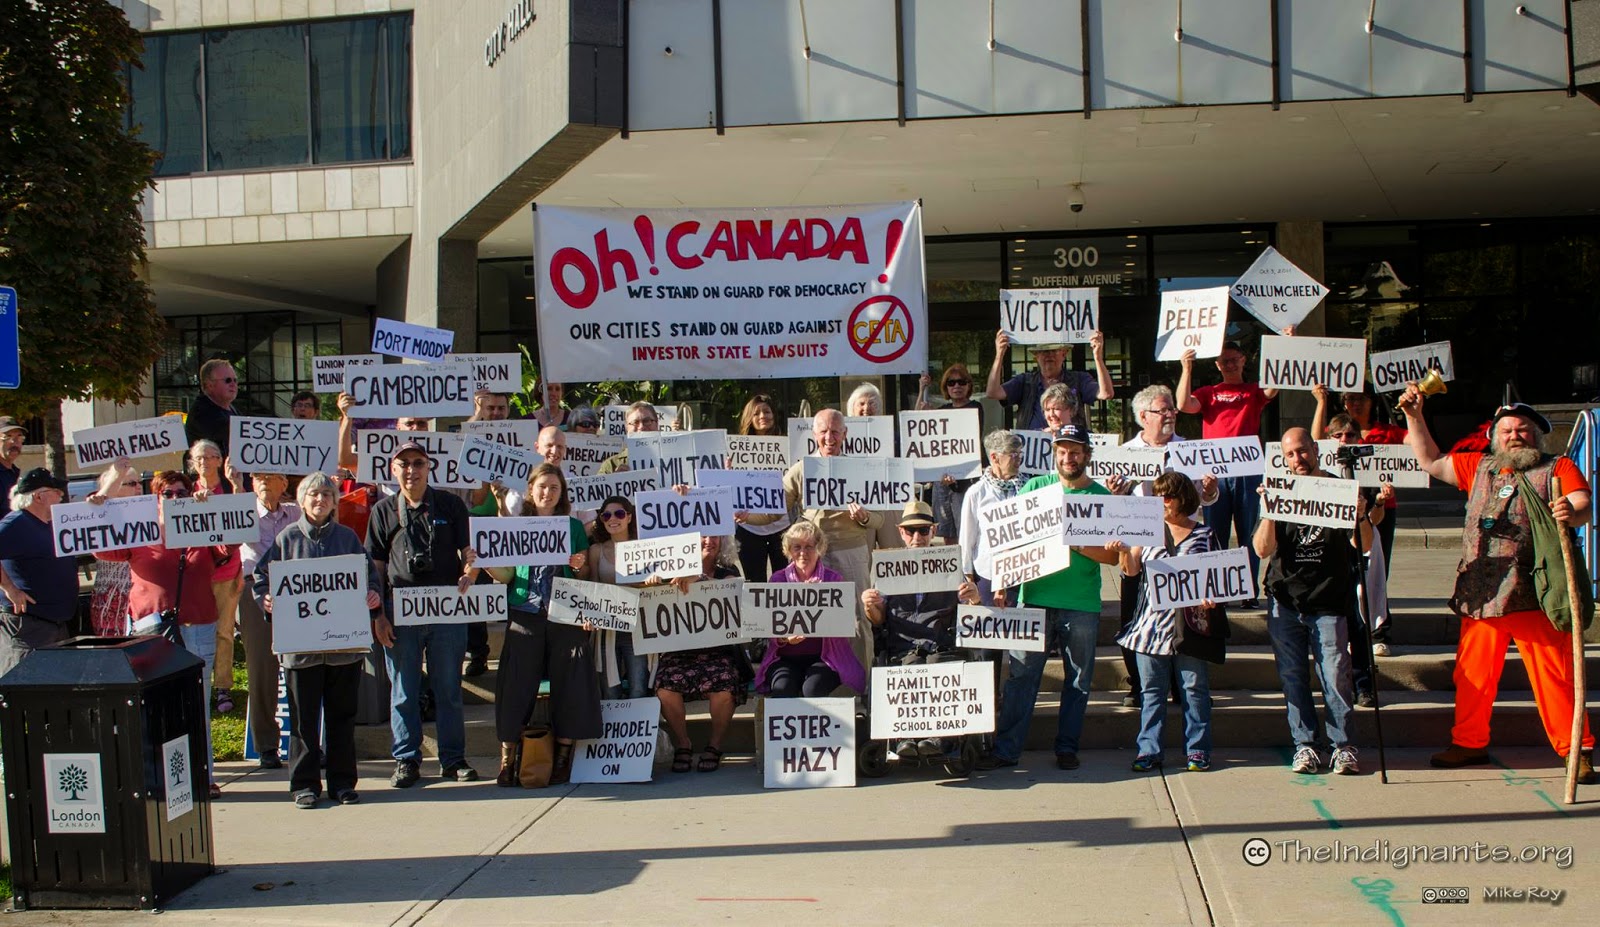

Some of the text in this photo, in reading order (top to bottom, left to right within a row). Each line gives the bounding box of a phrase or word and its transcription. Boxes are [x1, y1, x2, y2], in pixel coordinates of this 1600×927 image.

[485, 22, 507, 68] CITY
[550, 215, 659, 309] Oh!
[1053, 246, 1099, 268] 300
[627, 282, 867, 299] WE STAND ON GUARD FOR DEMOCRACY
[1032, 274, 1121, 287] DUFFERIN AVENUE
[1235, 284, 1320, 297] SPALLUMCHEEN
[1004, 300, 1094, 332] VICTORIA
[1273, 303, 1288, 312] BC
[1165, 306, 1219, 331] PELEE
[570, 322, 602, 340] OUR
[606, 321, 661, 339] CITIES
[670, 322, 716, 337] STAND
[720, 322, 738, 336] ON
[743, 321, 784, 336] GUARD
[788, 319, 843, 334] AGAINST
[374, 329, 411, 350] PORT
[411, 338, 451, 359] MOODY
[1183, 333, 1201, 347] ON
[632, 344, 829, 361] INVESTOR STATE LAWSUITS
[315, 359, 345, 370] UNION
[1264, 358, 1358, 389] NANAIMO
[1375, 356, 1445, 386] OSHAWA
[350, 375, 469, 406] CAMBRIDGE
[476, 382, 489, 390] BC
[240, 420, 305, 441] ESSEX
[609, 423, 627, 436] BOA
[907, 418, 949, 437] PORT
[77, 430, 171, 463] NIAGRA FALLS
[367, 433, 448, 454] POLL
[729, 441, 781, 452] GREATER
[807, 436, 881, 455] DMOND
[905, 438, 975, 458] ALBERNI
[240, 443, 331, 471] COUNTY
[563, 447, 620, 463] MBERLA
[727, 452, 786, 465] VICTORIA
[1175, 446, 1260, 467] WELLAND
[1354, 457, 1423, 472] EW TECUMSE
[1211, 465, 1228, 475] ON
[1379, 473, 1394, 482] ON
[567, 478, 656, 503] GRAND FORKS
[805, 477, 847, 506] FORT
[860, 480, 911, 505] JAMES
[1266, 477, 1296, 490] NEW
[733, 486, 784, 510] LESLEY
[1263, 494, 1356, 521] WESTMINSTER
[60, 511, 107, 523] District of
[641, 501, 721, 530] SLOCAN
[983, 496, 1040, 523] VILLE DE
[1066, 502, 1104, 518] NWT
[171, 509, 255, 533] TRENT HILLS
[986, 506, 1062, 549] BAIE-COMEA
[1065, 522, 1106, 536] Association
[1107, 527, 1113, 536] of
[1116, 525, 1154, 537] Communities
[59, 521, 160, 553] CHETWYND
[209, 534, 223, 542] ON
[476, 530, 567, 559] CRANBROOK
[624, 543, 697, 562] DISTRICT OF
[995, 545, 1046, 576] FRENCH
[627, 558, 685, 576] ELKFORD
[876, 558, 958, 578] GRAND FORKS
[1001, 563, 1041, 588] RIVER
[276, 571, 358, 596] ASHBURN
[1153, 565, 1248, 604] PORT ALICE
[298, 598, 331, 618] B.C.
[402, 595, 506, 617] DUNCAN BC
[554, 589, 567, 600] BC
[570, 595, 603, 612] School
[749, 588, 843, 608] THUNDER
[639, 594, 742, 640] LONDON
[772, 609, 823, 635] BAY
[726, 631, 738, 639] ON
[960, 614, 1040, 641] SACKVILLE
[887, 674, 961, 691] HAMILTON
[887, 688, 977, 705] WENTWORTH
[897, 703, 982, 718] DISTRICT ON
[602, 720, 658, 738] PHODEL-
[893, 719, 968, 732] SCHOOL BOARD
[586, 742, 652, 759] NORWOOD
[783, 746, 841, 773] HAZY
[601, 764, 620, 775] ON
[168, 791, 191, 809] London
[52, 809, 100, 821] London
